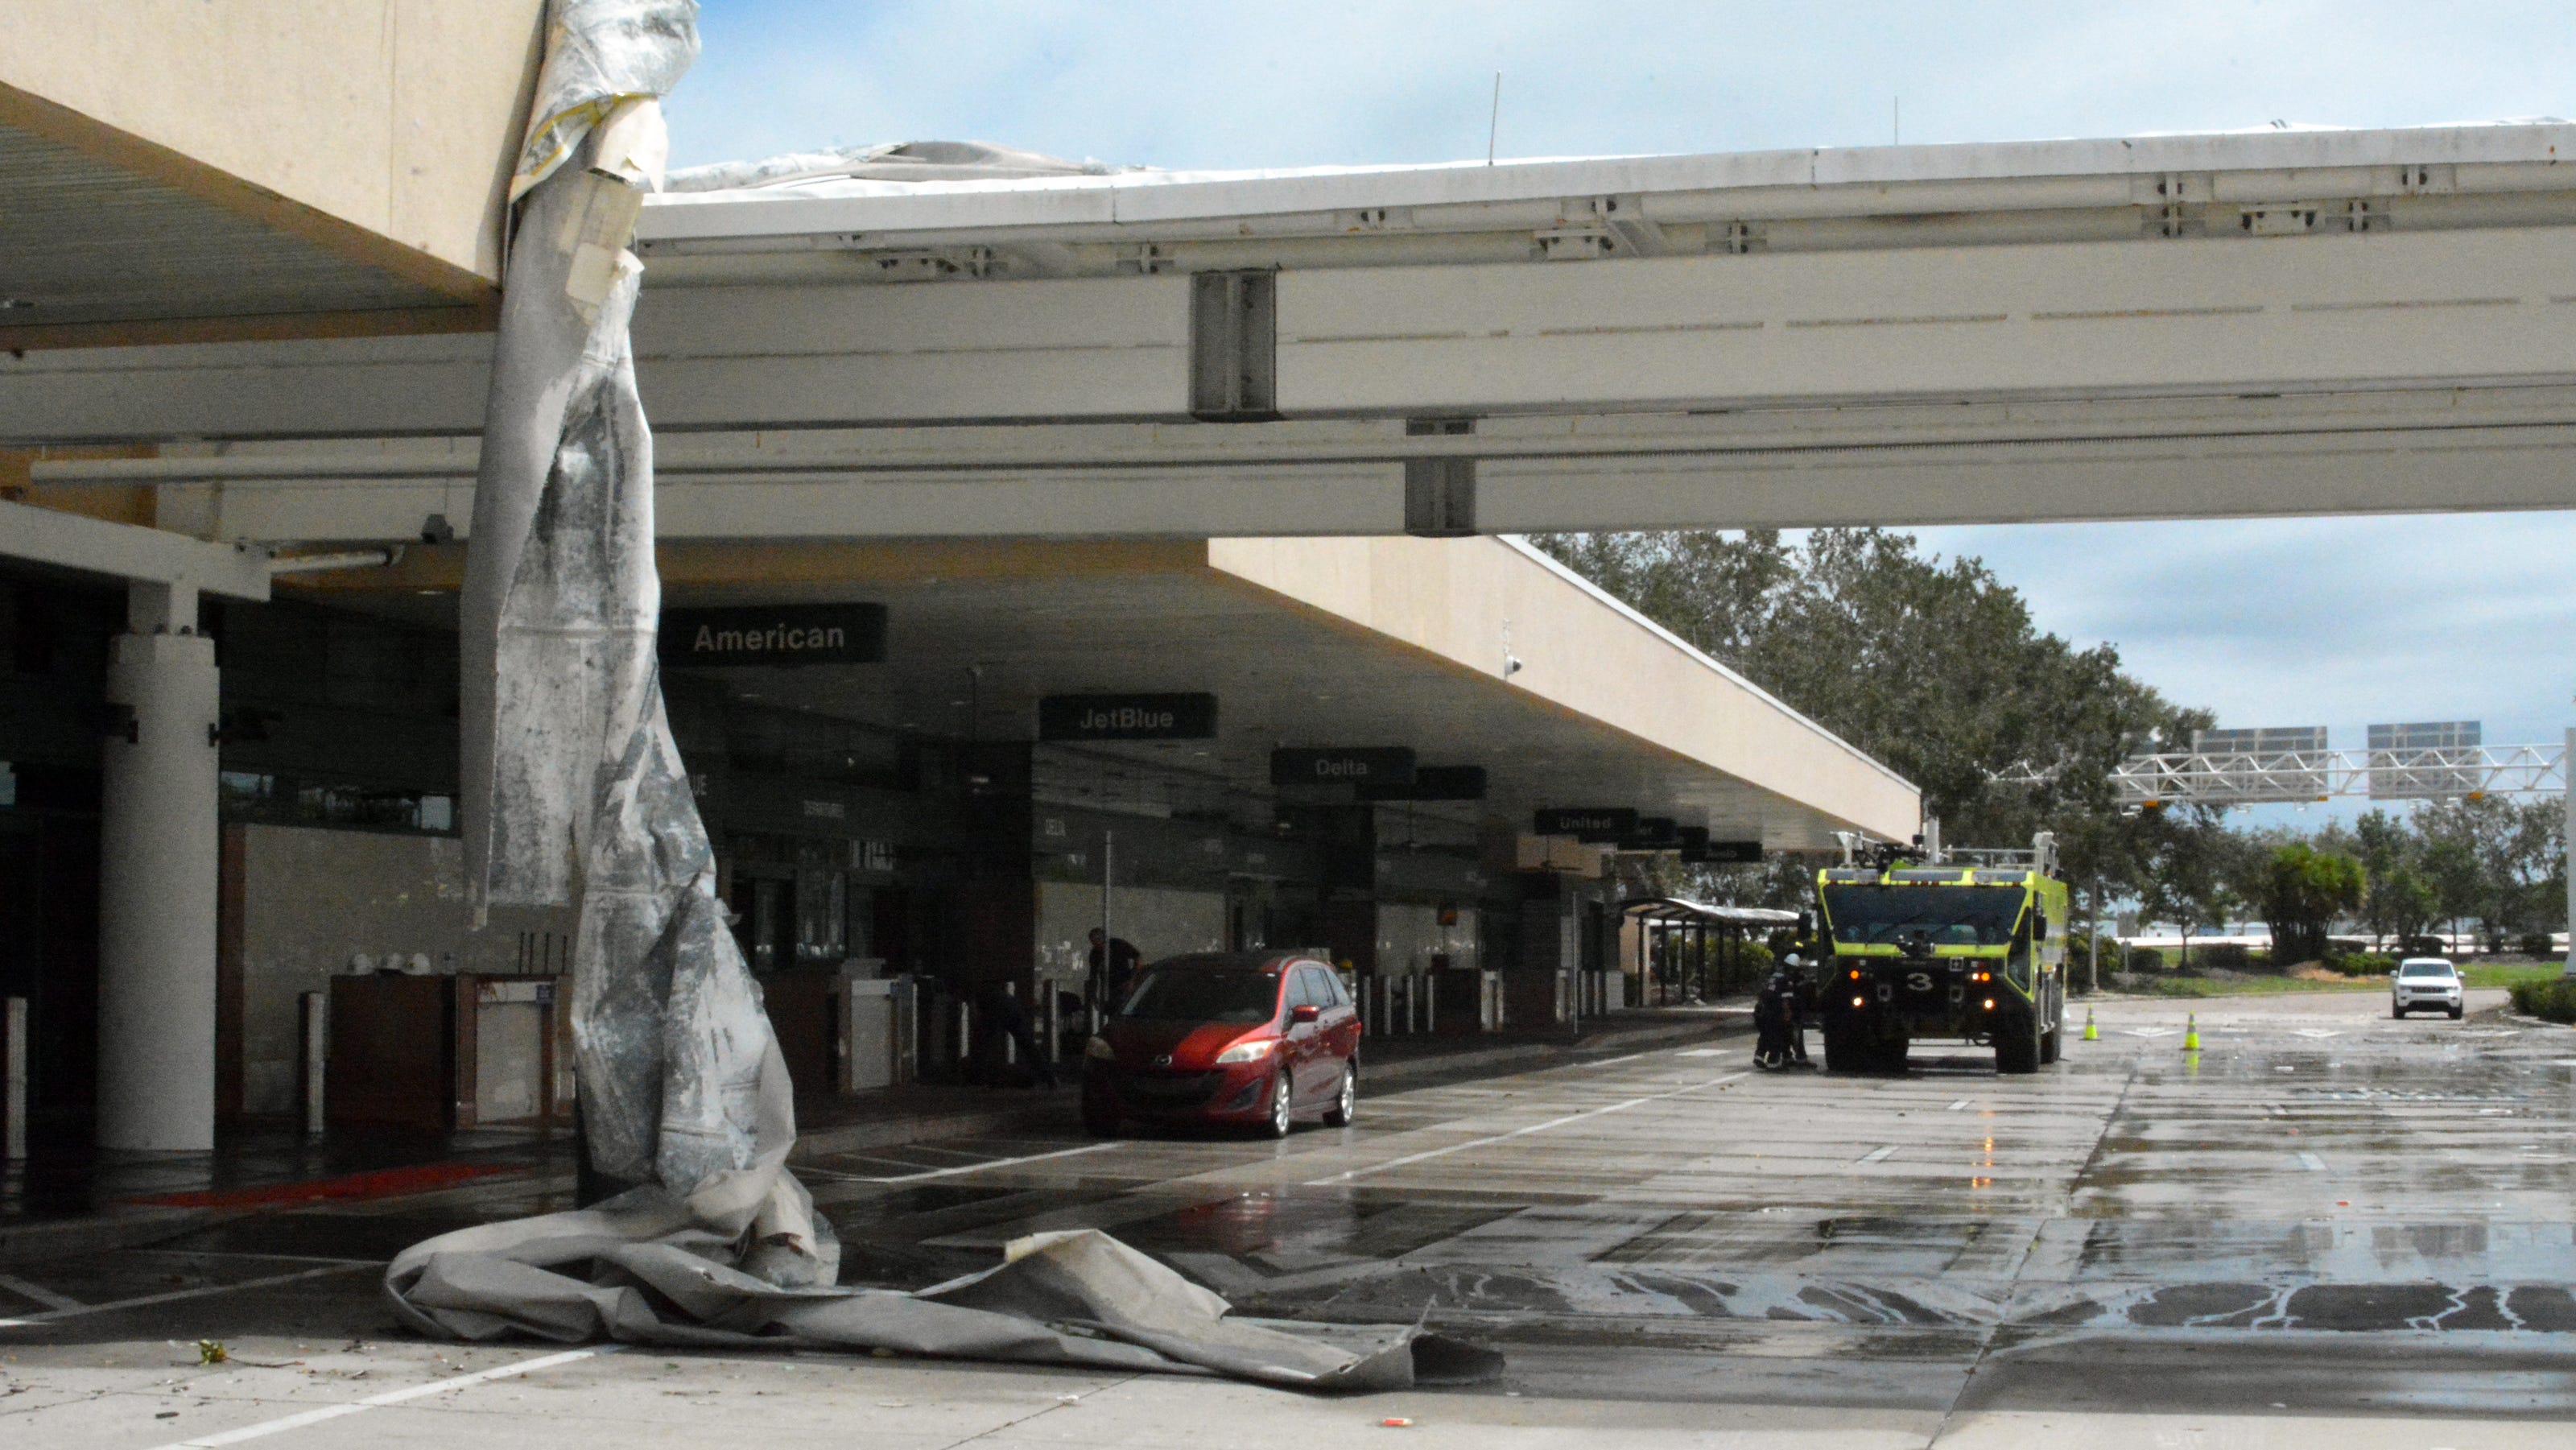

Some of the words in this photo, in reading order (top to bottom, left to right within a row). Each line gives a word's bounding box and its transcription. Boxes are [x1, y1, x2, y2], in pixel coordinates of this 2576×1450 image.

[694, 622, 844, 651] American
[1080, 708, 1174, 729] JetBlue
[1315, 759, 1368, 776] Delta
[1559, 816, 1611, 829] United
[1906, 972, 1934, 991] 3
